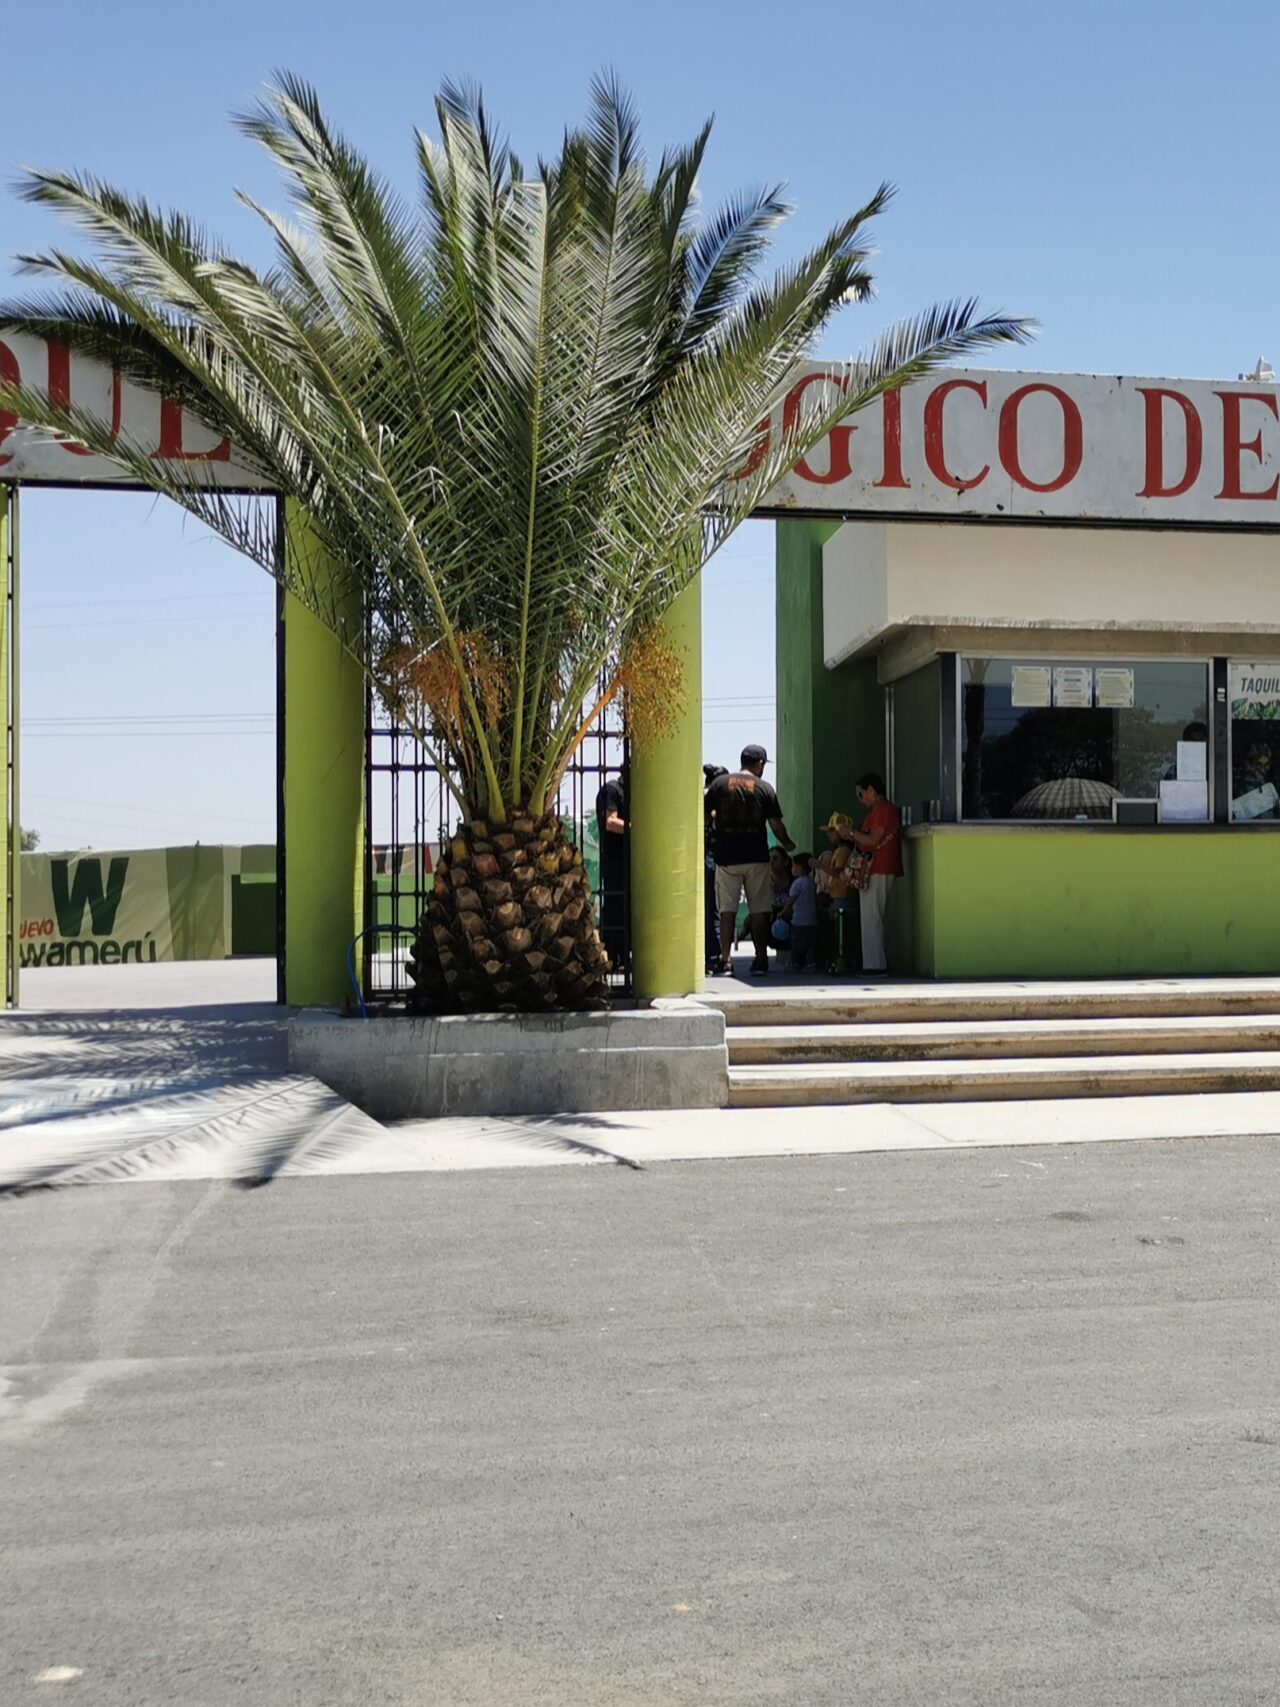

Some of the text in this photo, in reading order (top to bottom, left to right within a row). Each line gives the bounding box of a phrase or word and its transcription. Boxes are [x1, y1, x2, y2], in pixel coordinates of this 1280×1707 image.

[728, 373, 1083, 492] GICO
[1134, 387, 1280, 500] DE
[20, 917, 54, 940] UEVO
[51, 857, 130, 938] W
